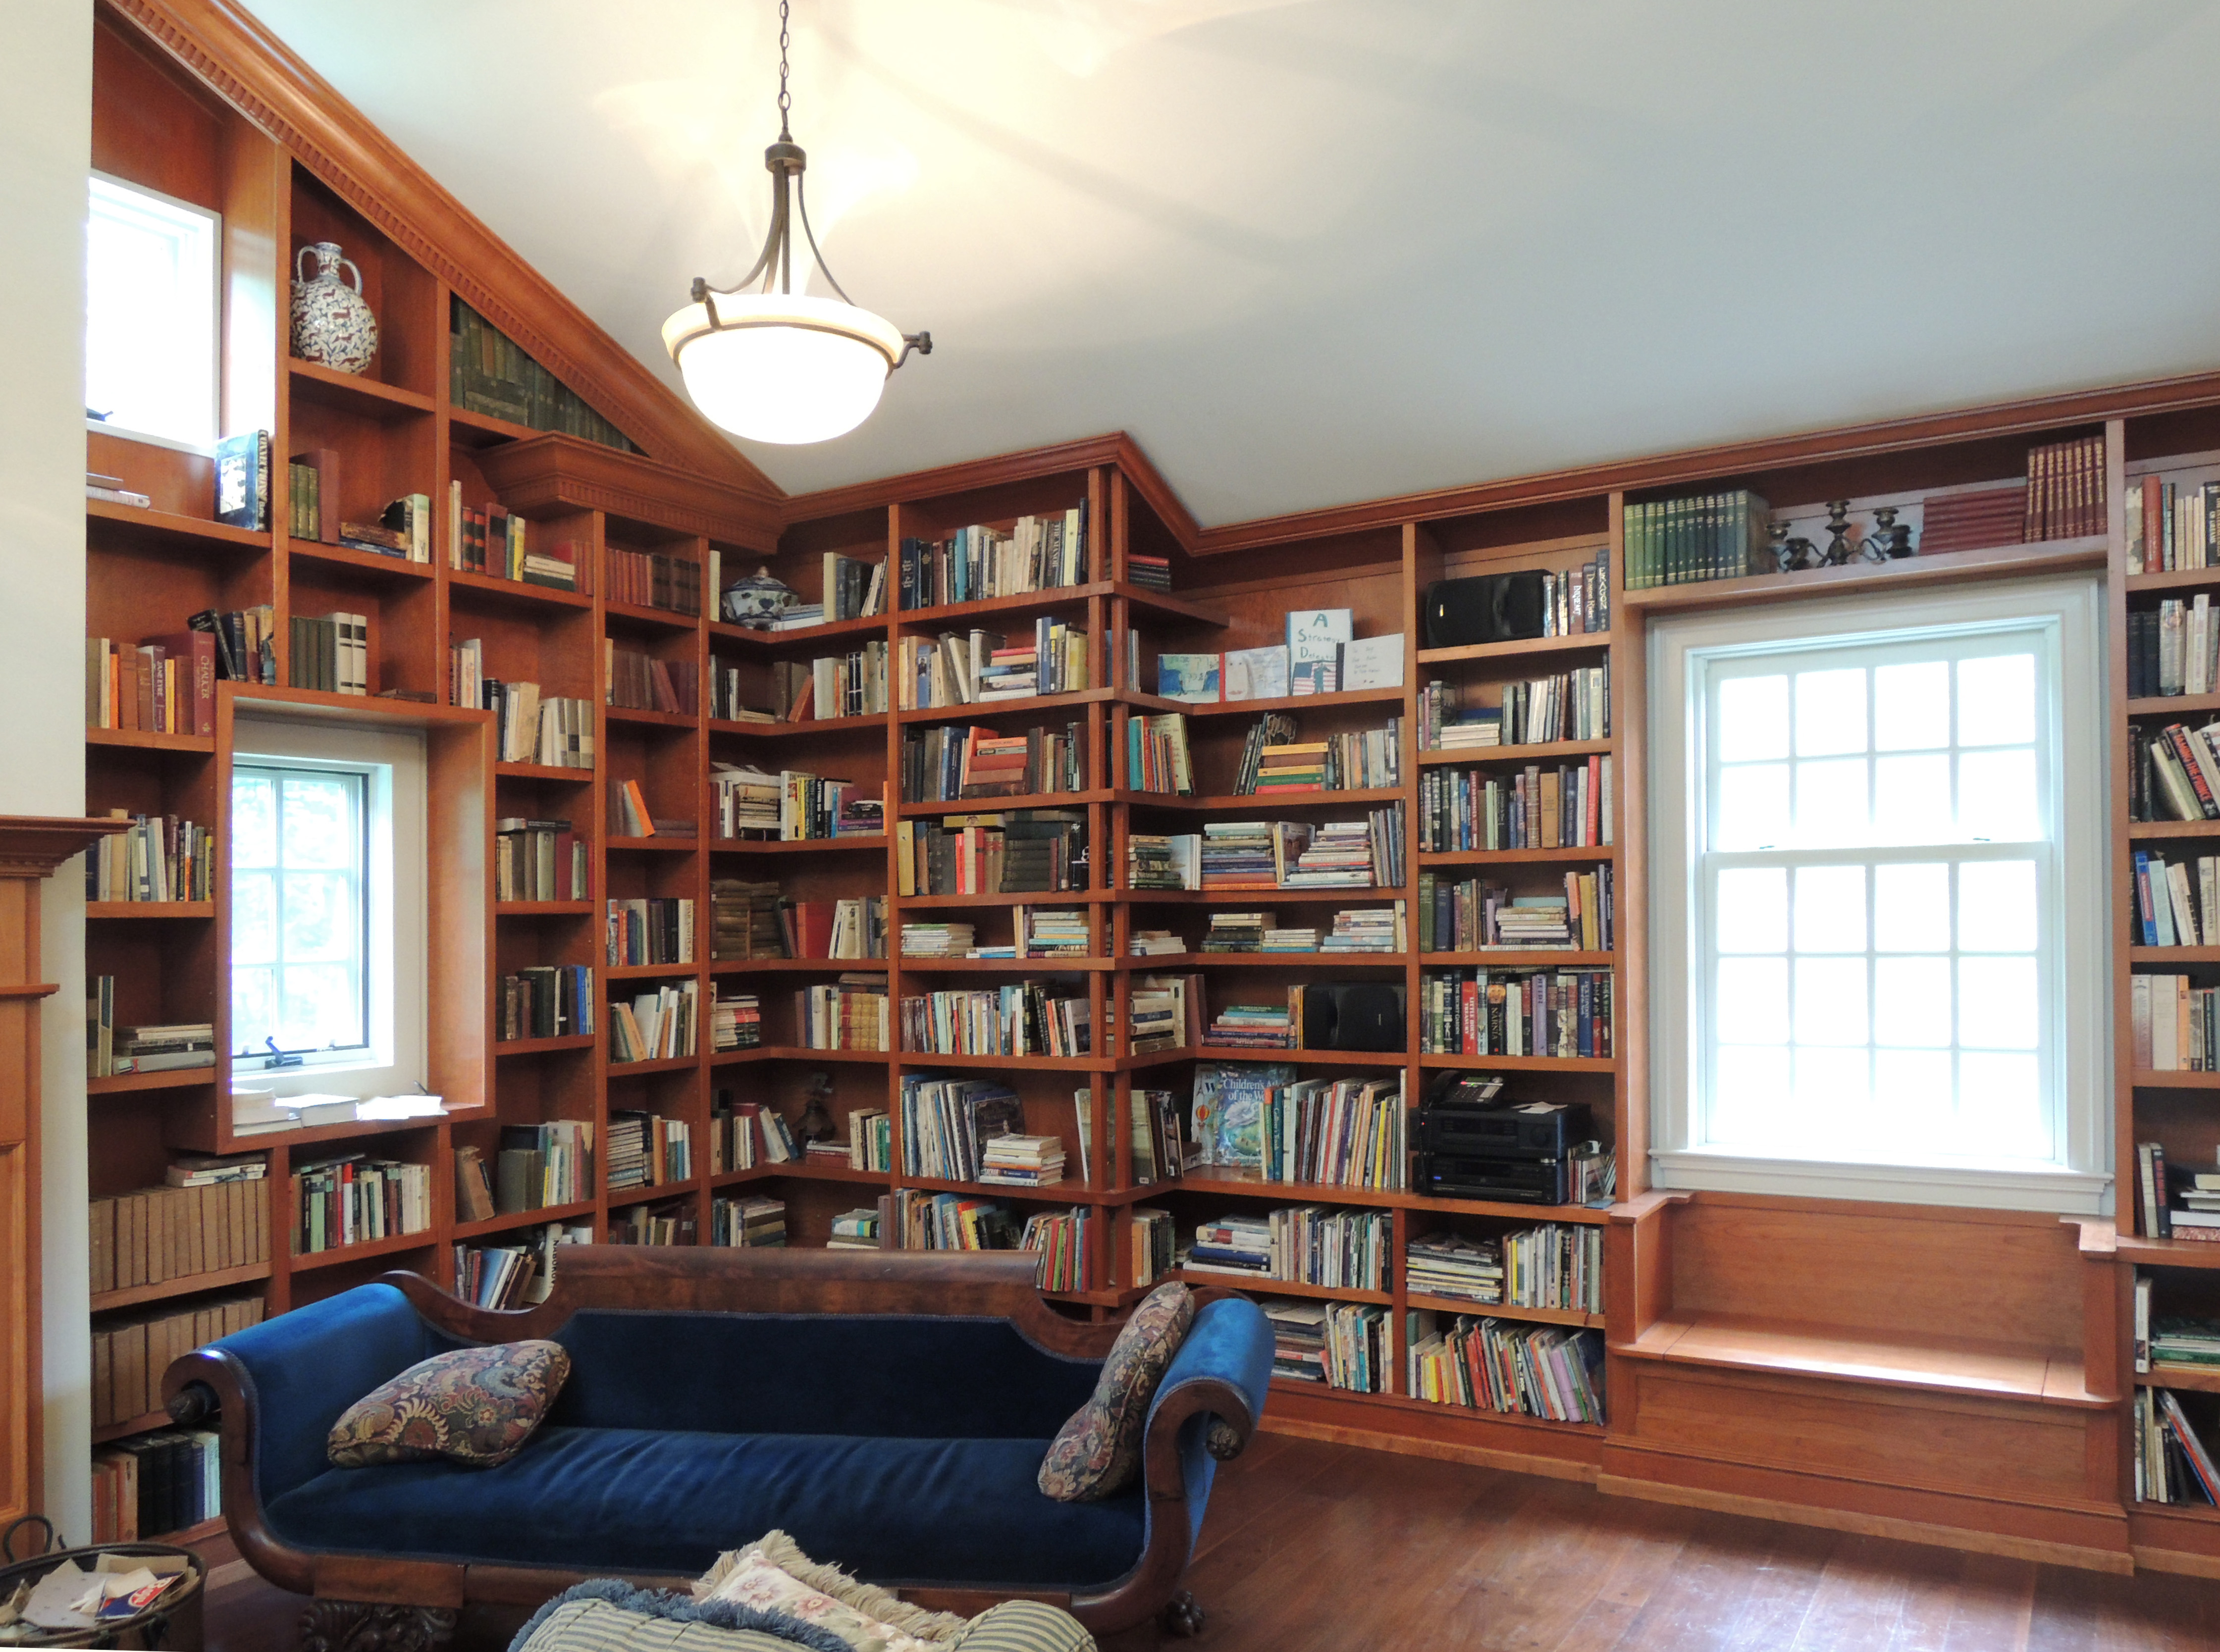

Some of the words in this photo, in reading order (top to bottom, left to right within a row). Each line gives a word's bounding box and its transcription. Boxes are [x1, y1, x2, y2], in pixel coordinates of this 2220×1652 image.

[1586, 572, 1595, 599] Dragon
[1598, 567, 1607, 611] ERAGON
[1586, 600, 1595, 620] Rider
[1313, 613, 1328, 628] A
[1298, 628, 1340, 643] Strategy
[201, 655, 209, 699] CHAUCER
[1223, 1079, 1264, 1089] Children's
[1228, 1090, 1239, 1100] of
[1239, 1090, 1252, 1100] the
